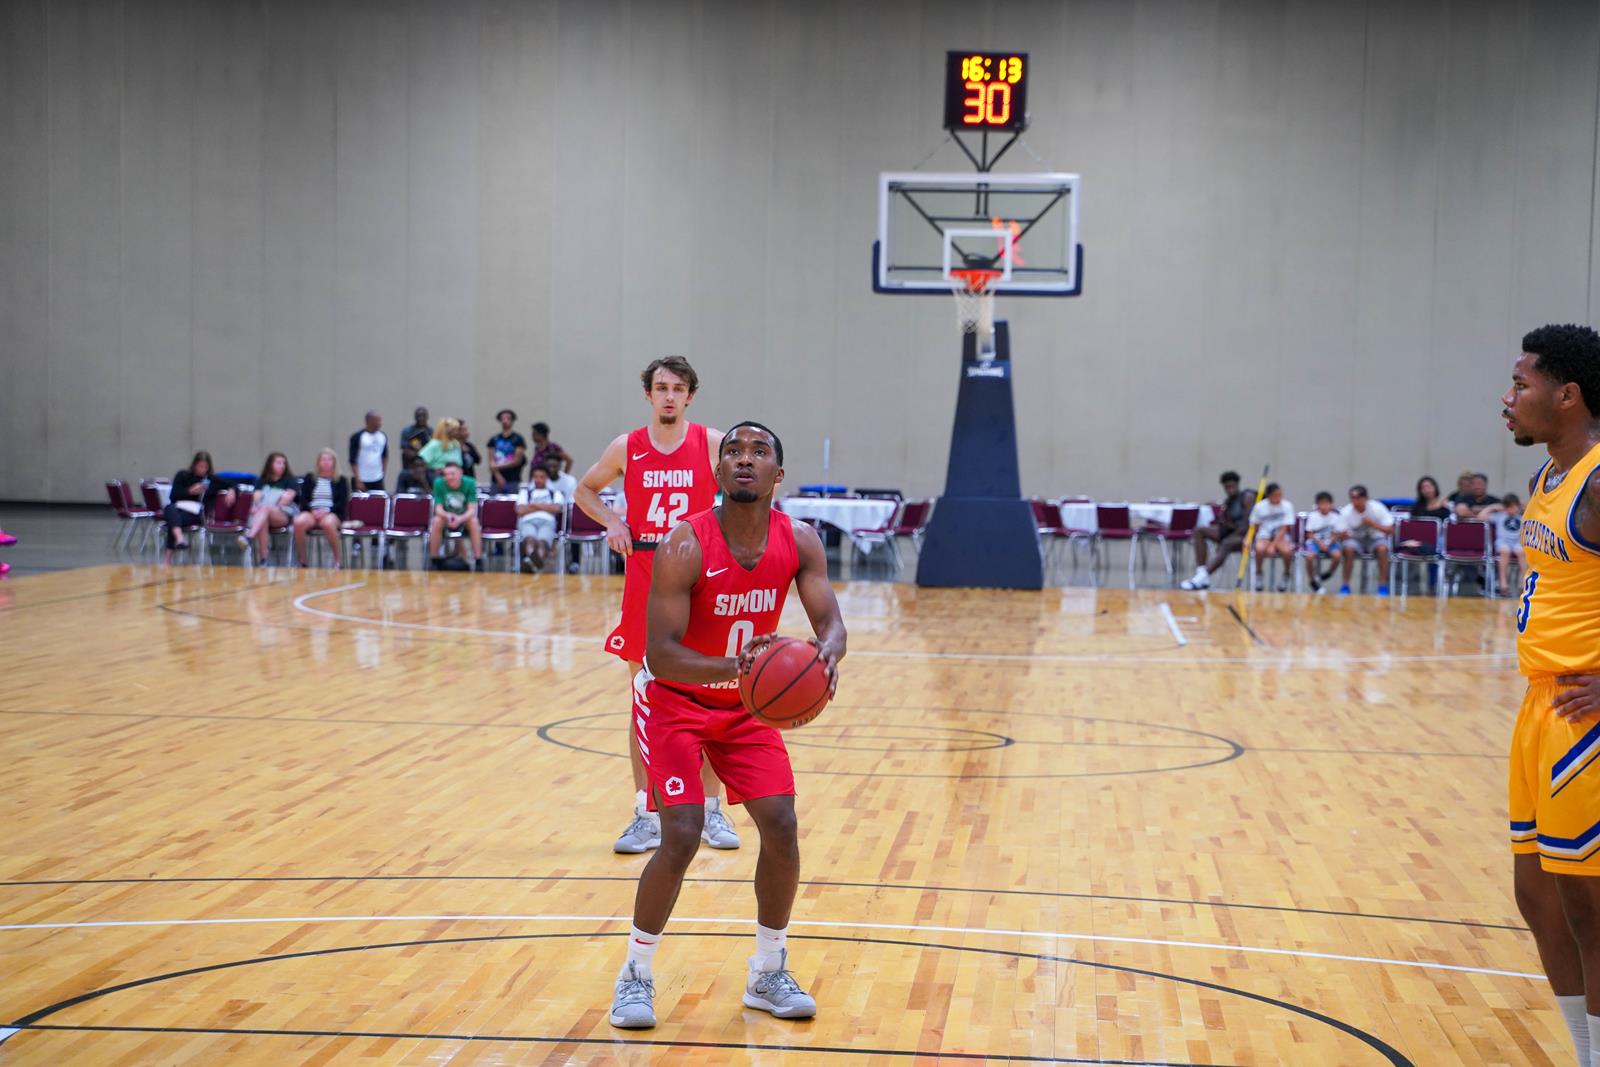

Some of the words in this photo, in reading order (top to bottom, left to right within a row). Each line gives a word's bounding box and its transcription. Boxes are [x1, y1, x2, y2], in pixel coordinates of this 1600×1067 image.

[961, 56, 1022, 83] 16:13
[963, 81, 1011, 124] 30
[642, 469, 694, 488] SIMON
[646, 492, 689, 528] 42
[714, 588, 777, 617] SIMON
[725, 620, 755, 658] 0
